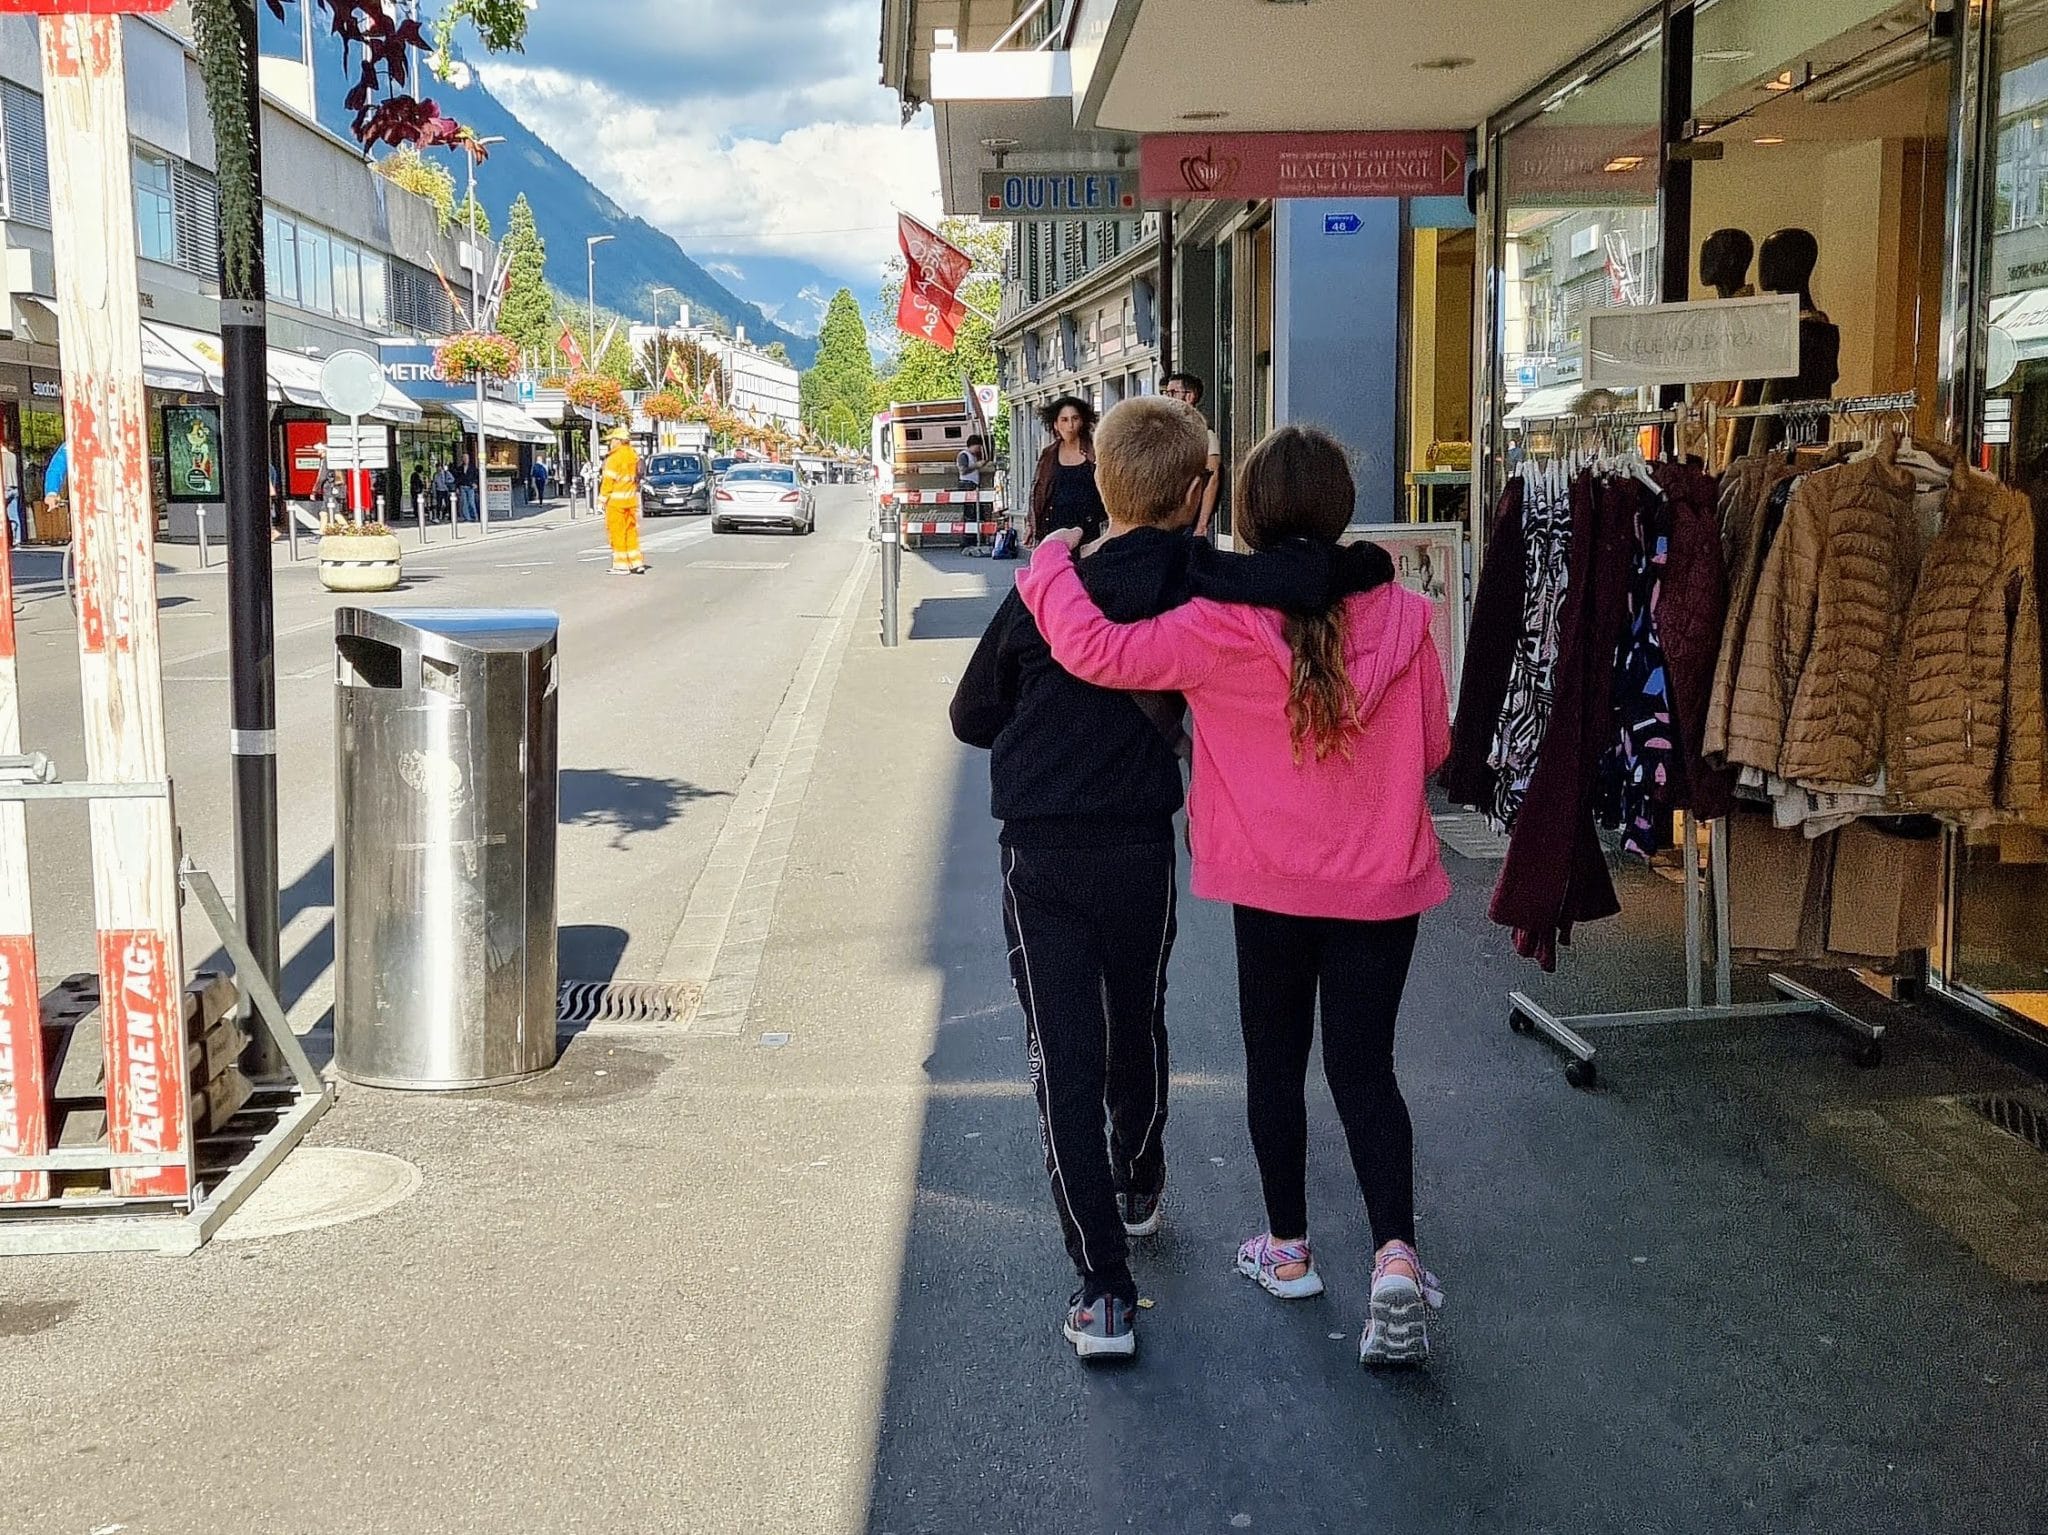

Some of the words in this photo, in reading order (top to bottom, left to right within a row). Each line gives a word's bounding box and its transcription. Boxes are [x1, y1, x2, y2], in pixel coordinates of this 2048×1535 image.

[1281, 161, 1351, 178] BEAUTY
[1355, 161, 1433, 178] LOUNGE
[1003, 174, 1121, 210] OUTLET
[122, 944, 156, 1002] AG
